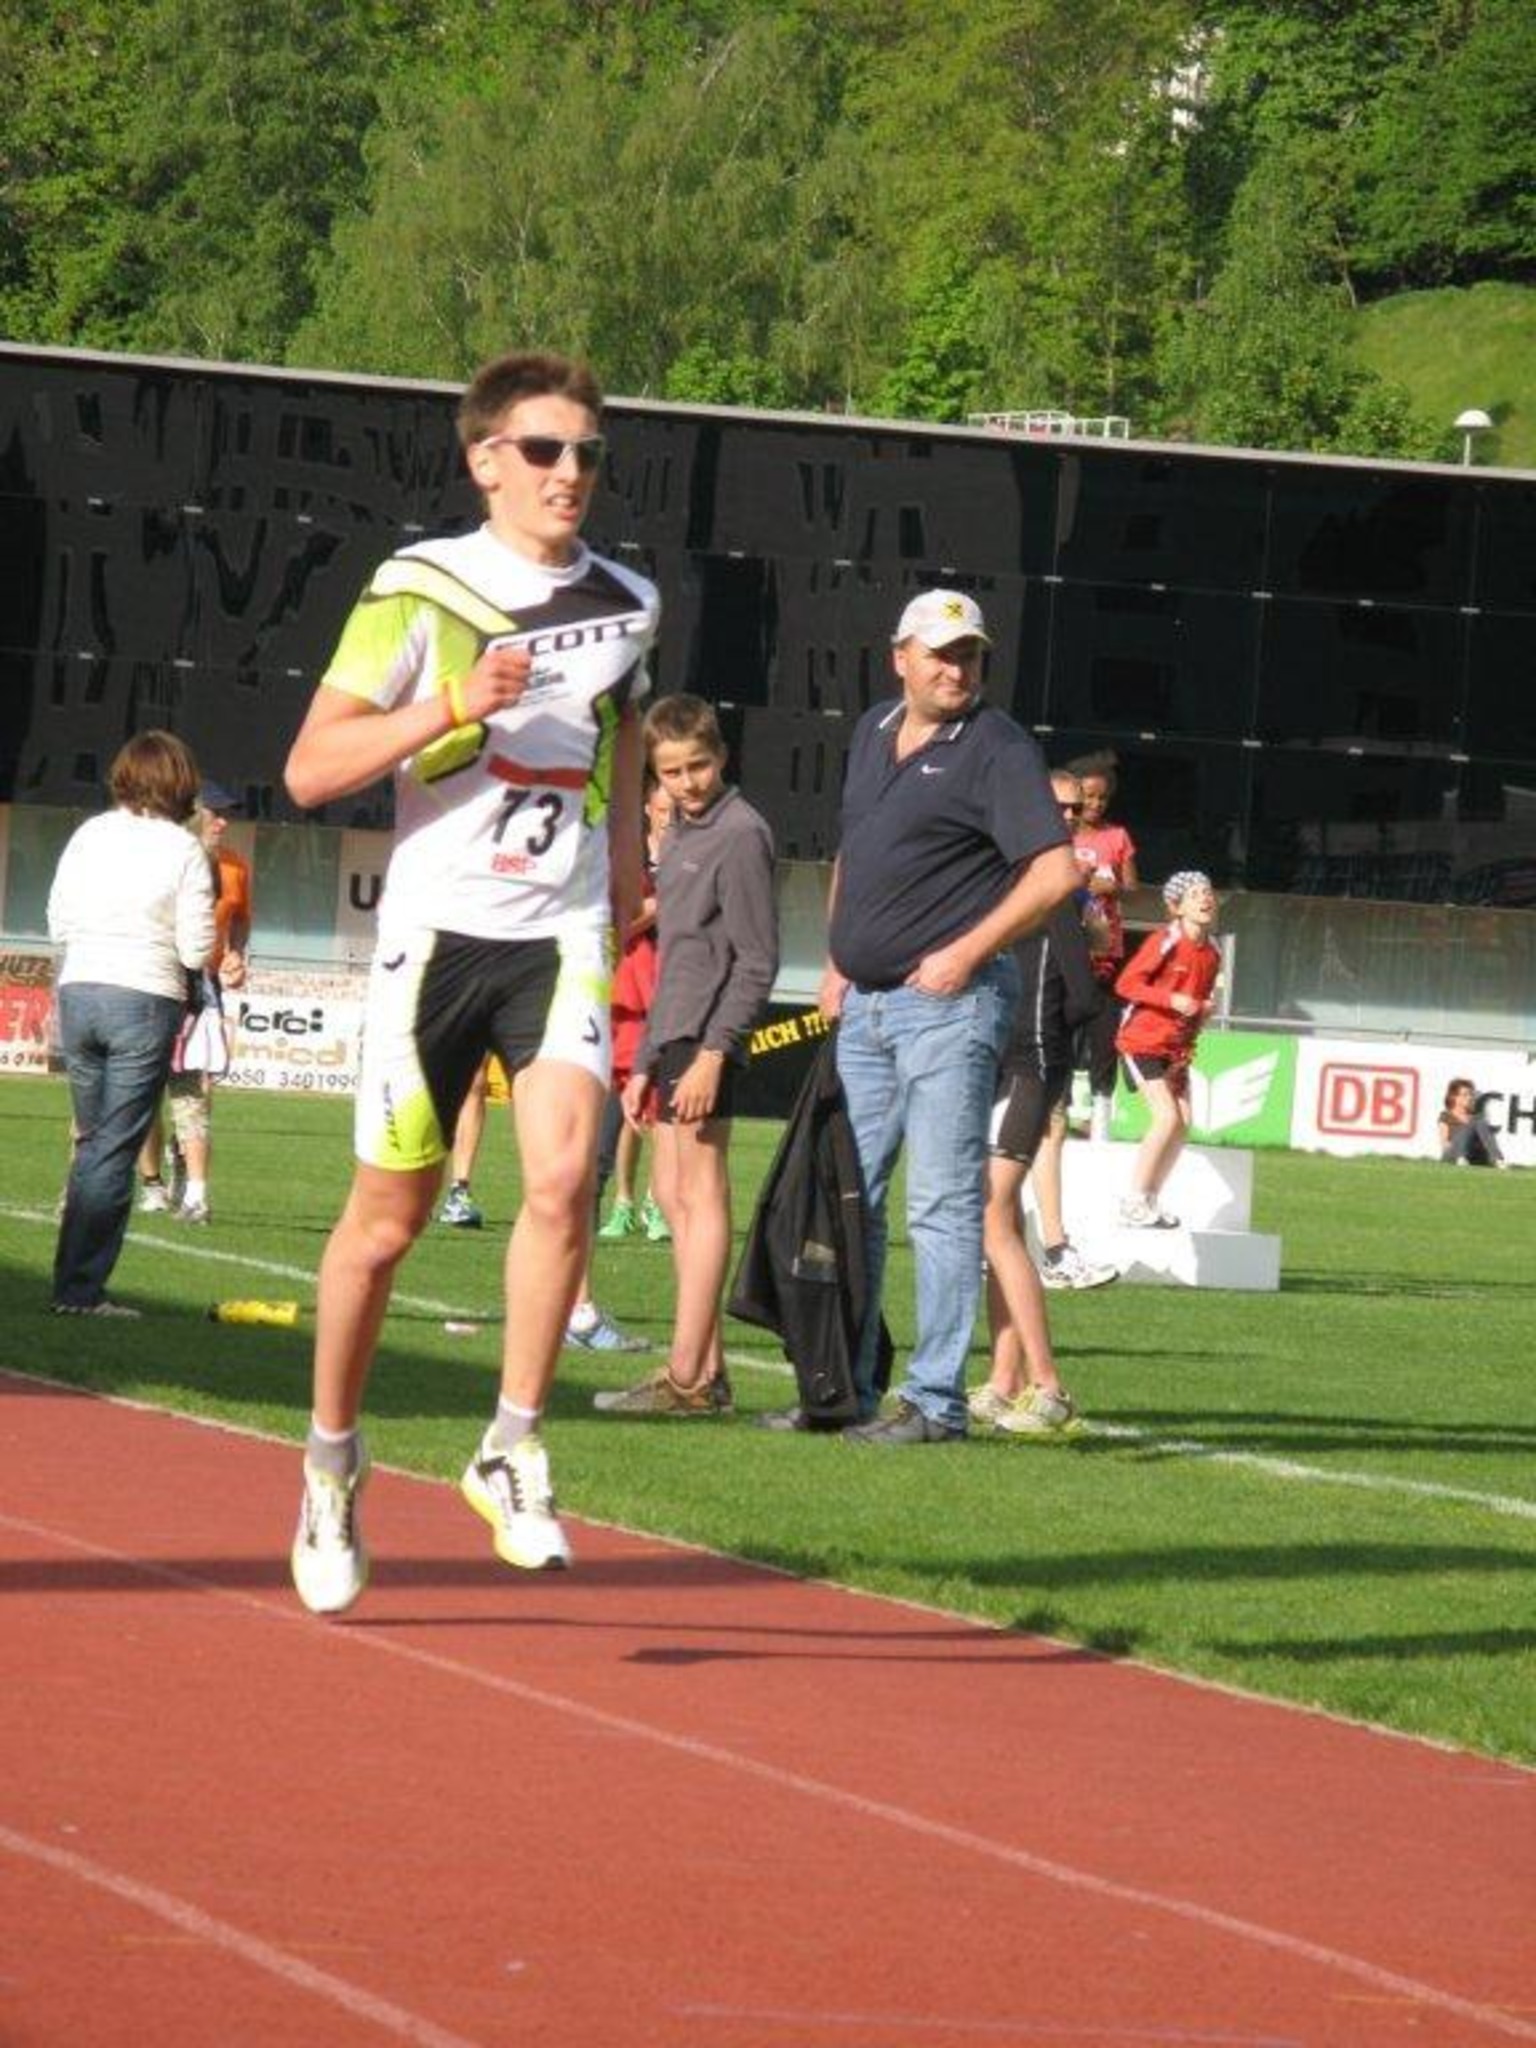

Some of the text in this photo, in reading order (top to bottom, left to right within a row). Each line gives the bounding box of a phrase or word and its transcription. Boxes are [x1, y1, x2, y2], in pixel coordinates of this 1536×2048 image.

[495, 617, 637, 657] COTT
[493, 789, 564, 856] 73
[1330, 1075, 1405, 1126] DB
